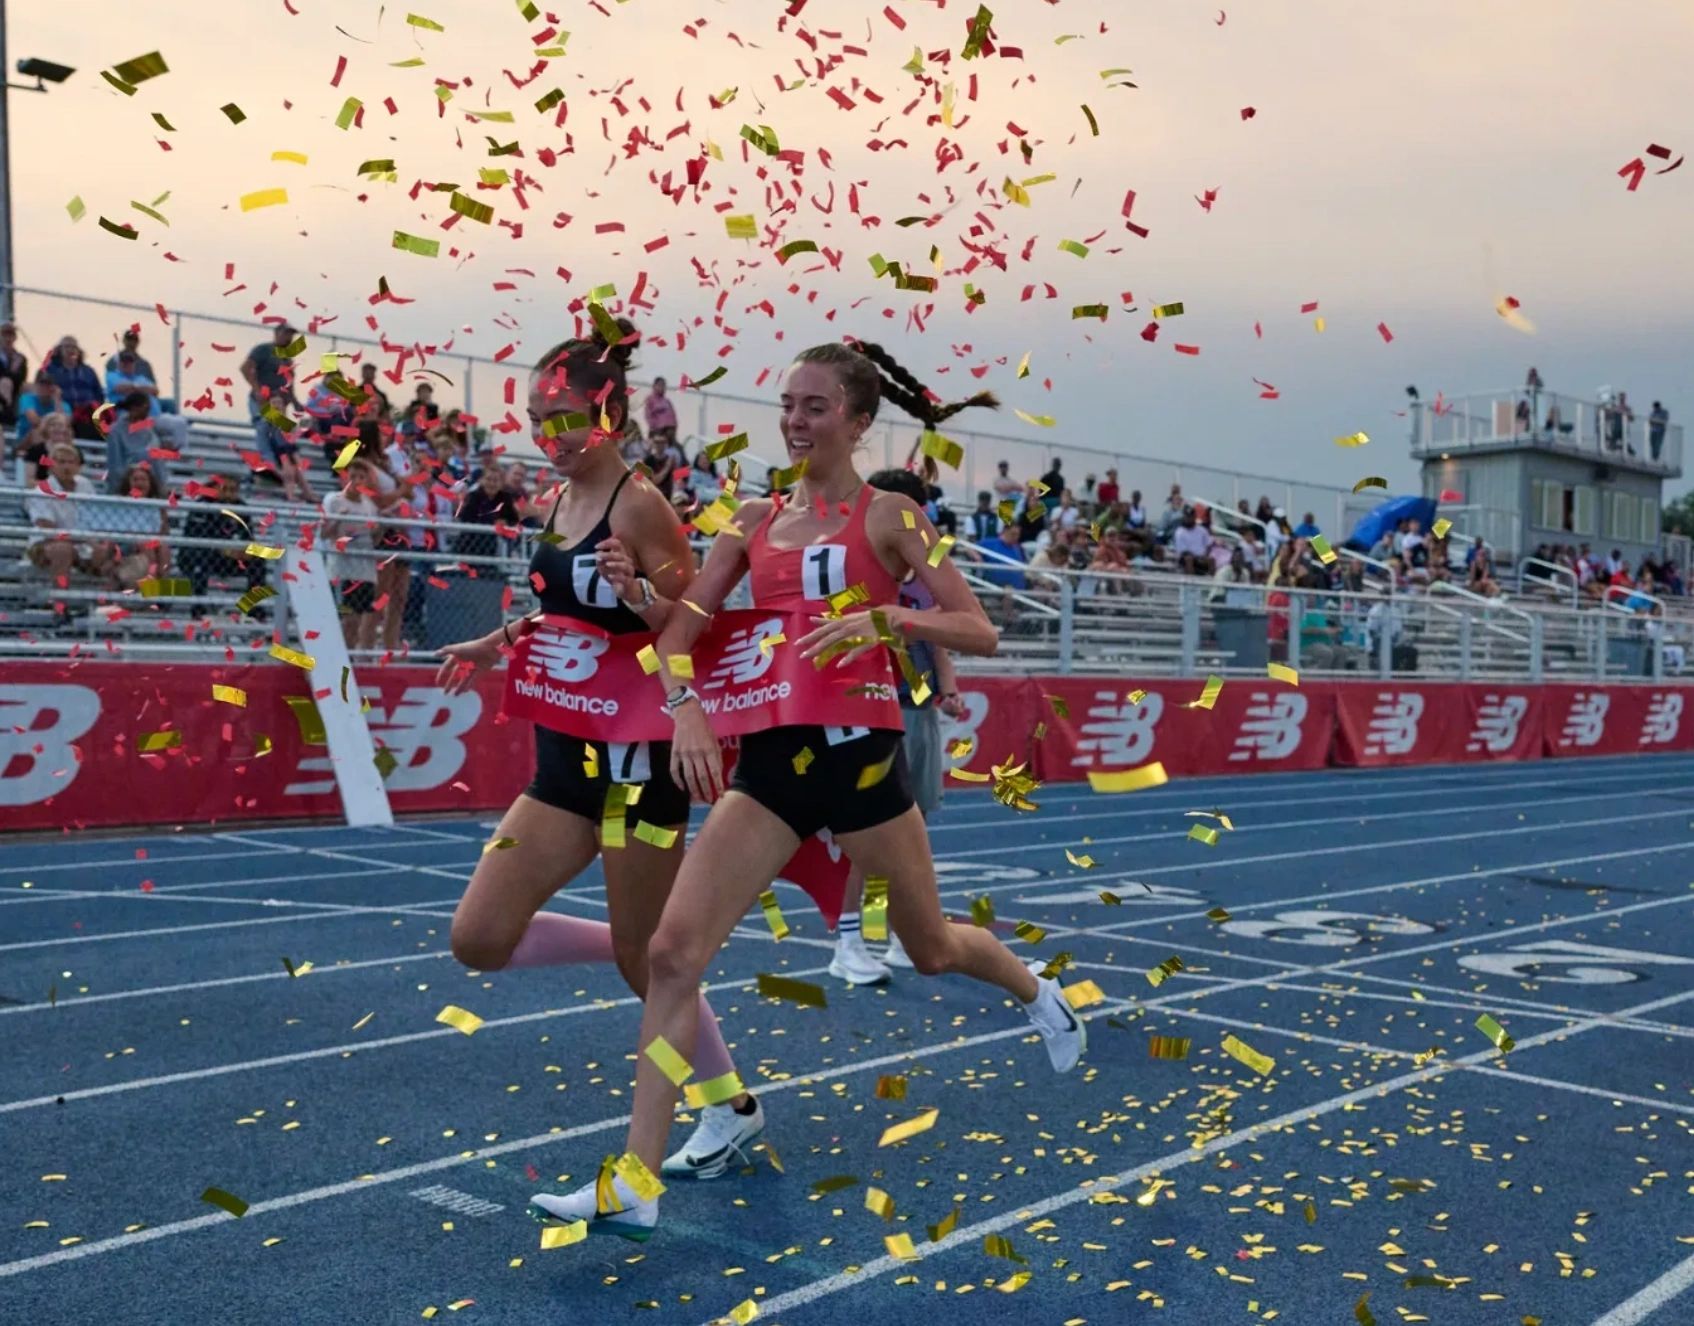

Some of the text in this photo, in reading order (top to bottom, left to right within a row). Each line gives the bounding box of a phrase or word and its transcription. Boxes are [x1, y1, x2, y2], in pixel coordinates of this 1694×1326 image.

[809, 547, 830, 595] 1
[514, 678, 619, 716] new balance
[722, 681, 791, 712] balance
[864, 682, 898, 701] ne
[0, 683, 102, 807] B
